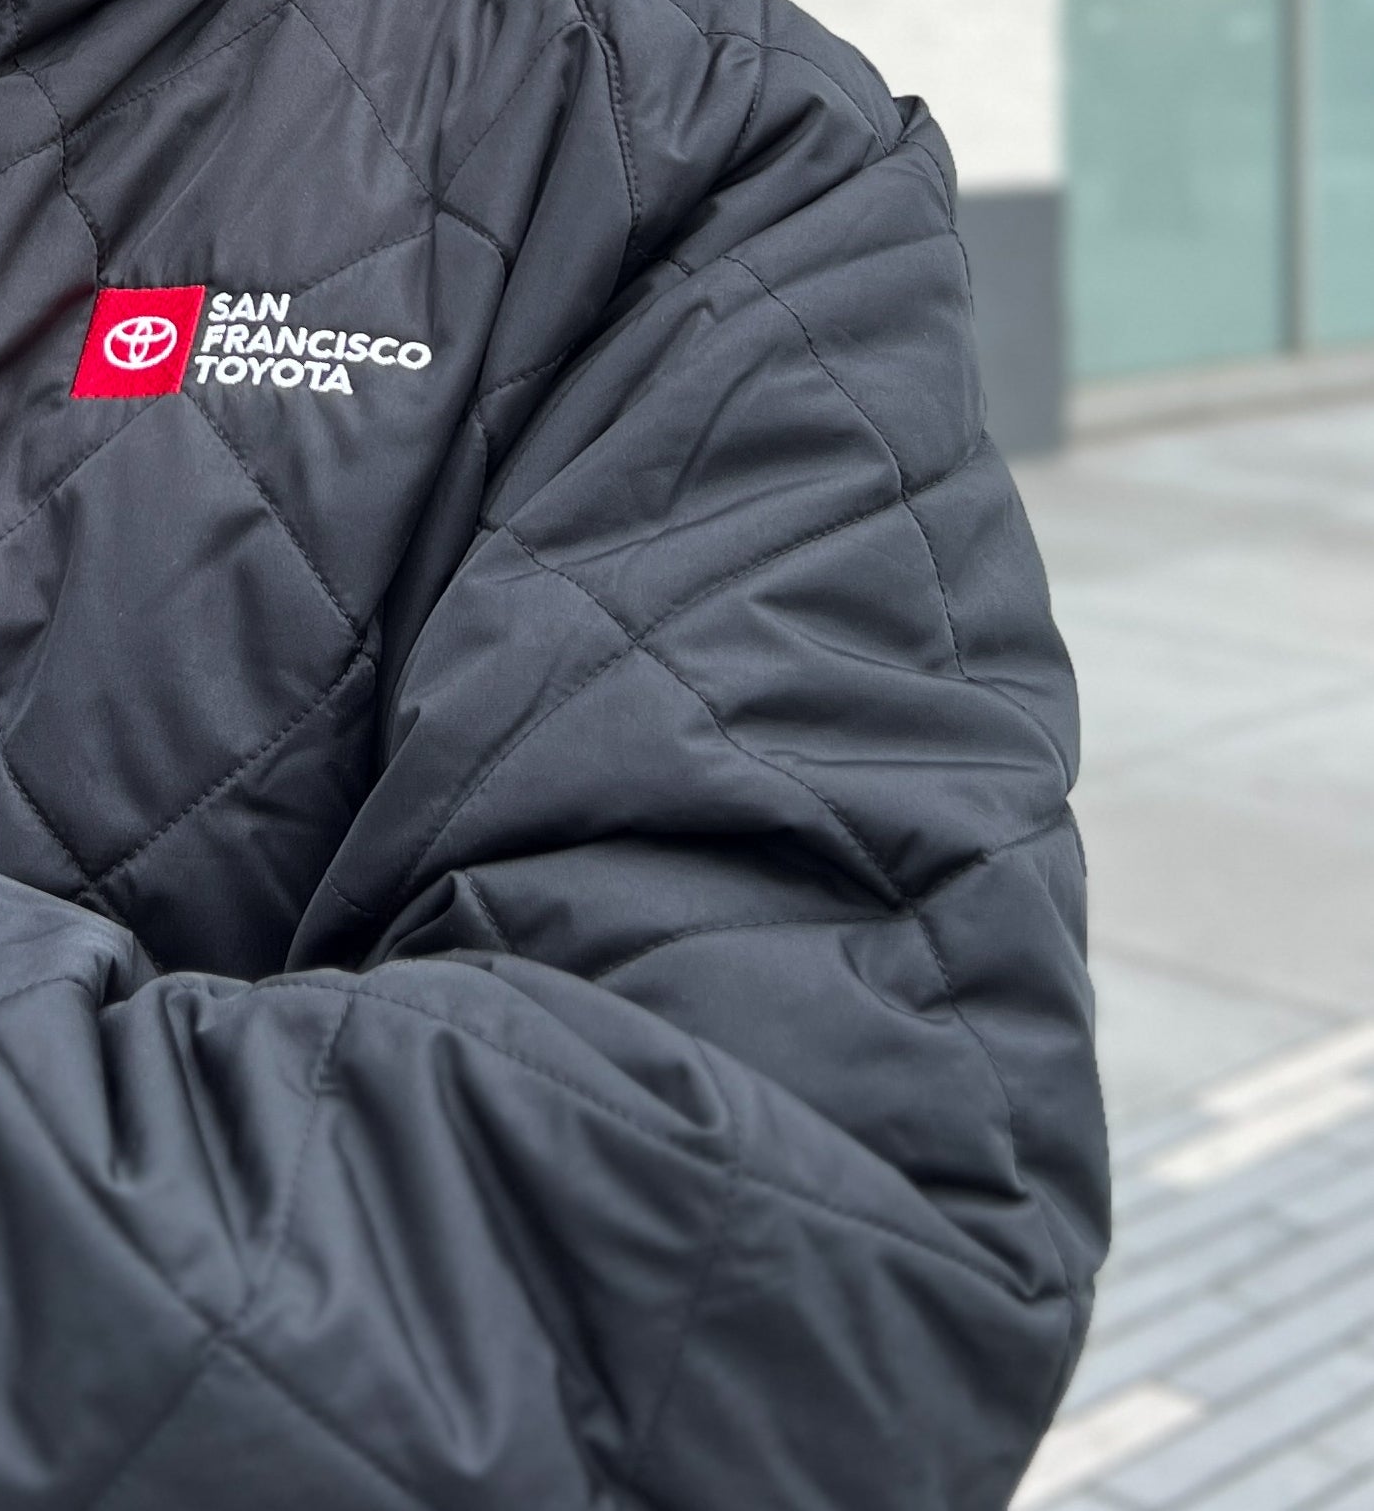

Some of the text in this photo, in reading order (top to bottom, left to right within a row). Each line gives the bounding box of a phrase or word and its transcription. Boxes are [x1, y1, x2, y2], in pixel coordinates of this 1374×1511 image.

[207, 292, 291, 323] SAN
[199, 324, 432, 371] FRANCISCO
[194, 354, 354, 395] TOYOTA
